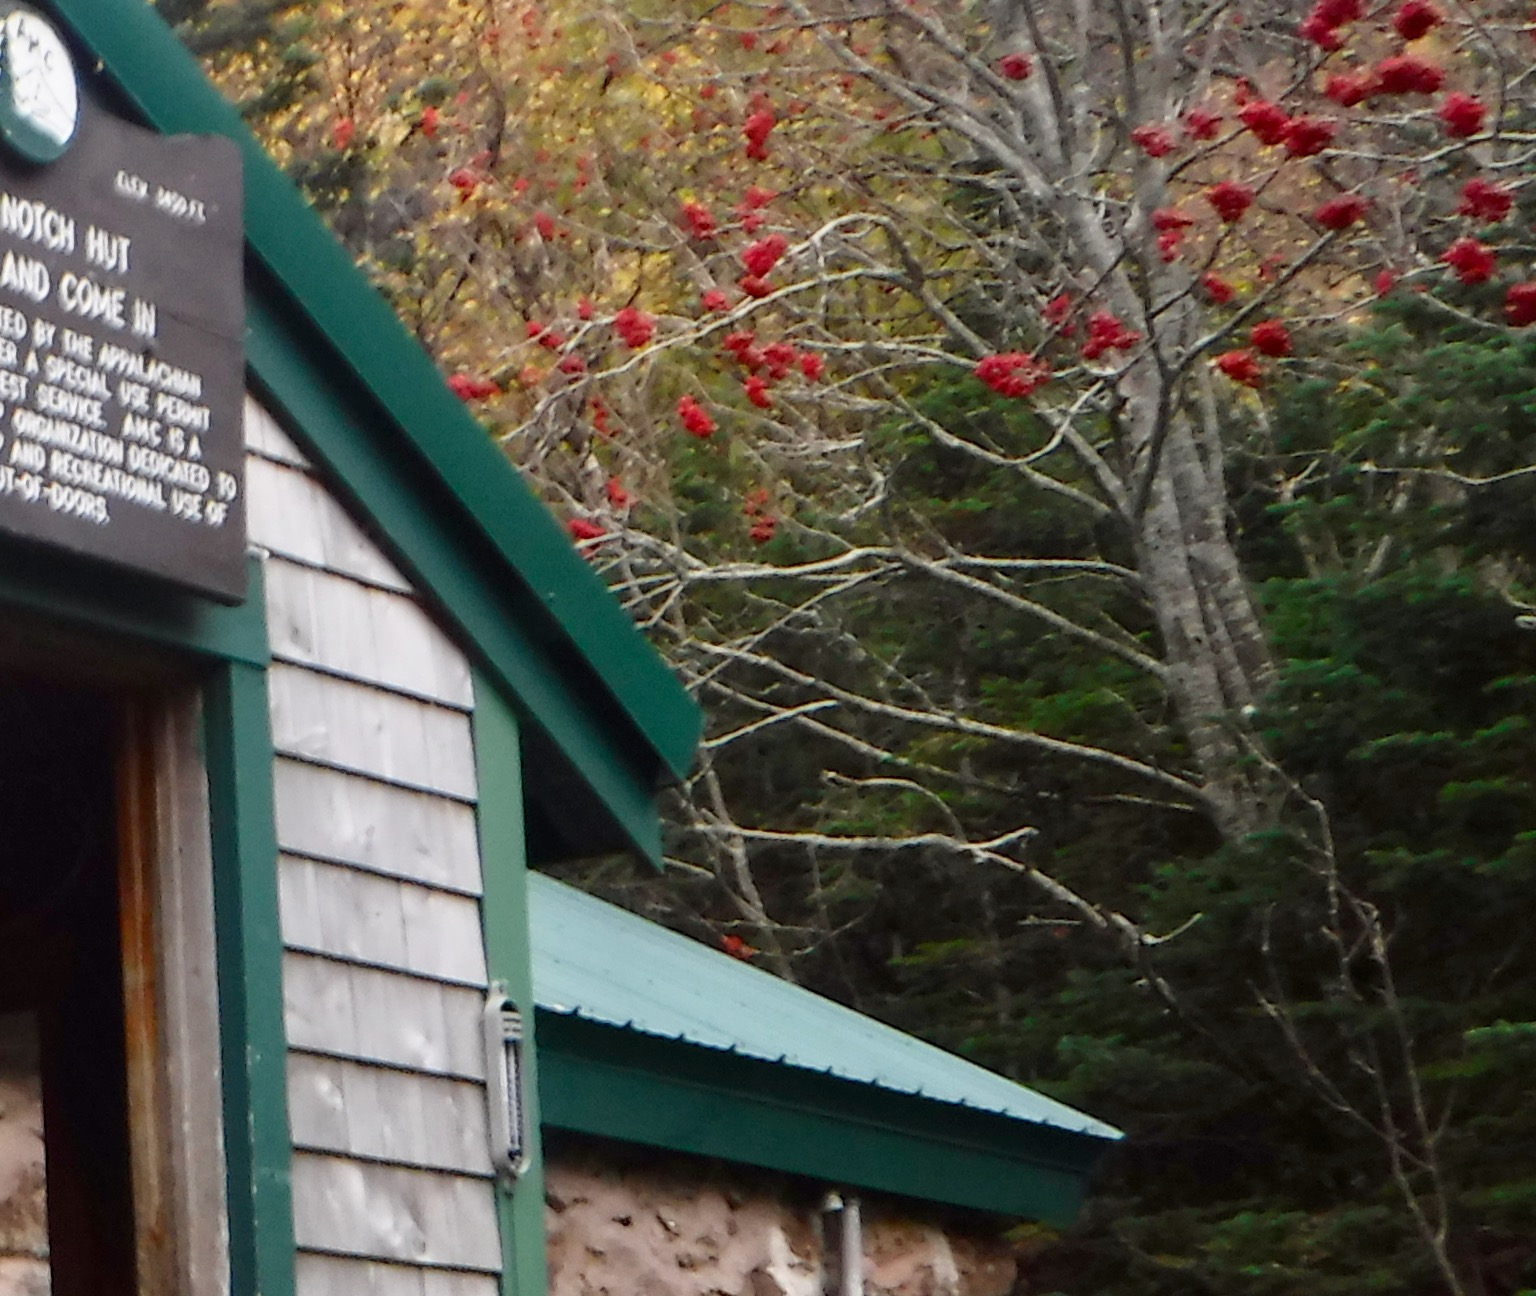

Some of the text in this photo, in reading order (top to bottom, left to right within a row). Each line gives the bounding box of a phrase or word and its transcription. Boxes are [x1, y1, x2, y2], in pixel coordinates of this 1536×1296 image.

[0, 193, 75, 254] NOTCH
[85, 226, 131, 273] HUT
[0, 250, 50, 302] AND
[58, 272, 126, 329] COME
[131, 299, 157, 338] IN
[24, 348, 39, 376] A
[43, 354, 112, 399] SPECIAL
[117, 378, 150, 413] USE
[155, 392, 210, 431] PERMIT
[32, 318, 56, 349] BY
[61, 328, 93, 364] THE
[97, 343, 202, 400] APPALACHIAN
[11, 407, 124, 468] ORGANIZATION
[128, 444, 210, 493] DEDICATED
[215, 470, 237, 501] TO
[121, 412, 162, 447] AMC
[167, 427, 185, 454] IS
[188, 434, 202, 460] A
[10, 439, 46, 473] AND
[50, 450, 167, 511] RECREATIONAL
[170, 488, 203, 522] USE
[204, 500, 228, 528] OF
